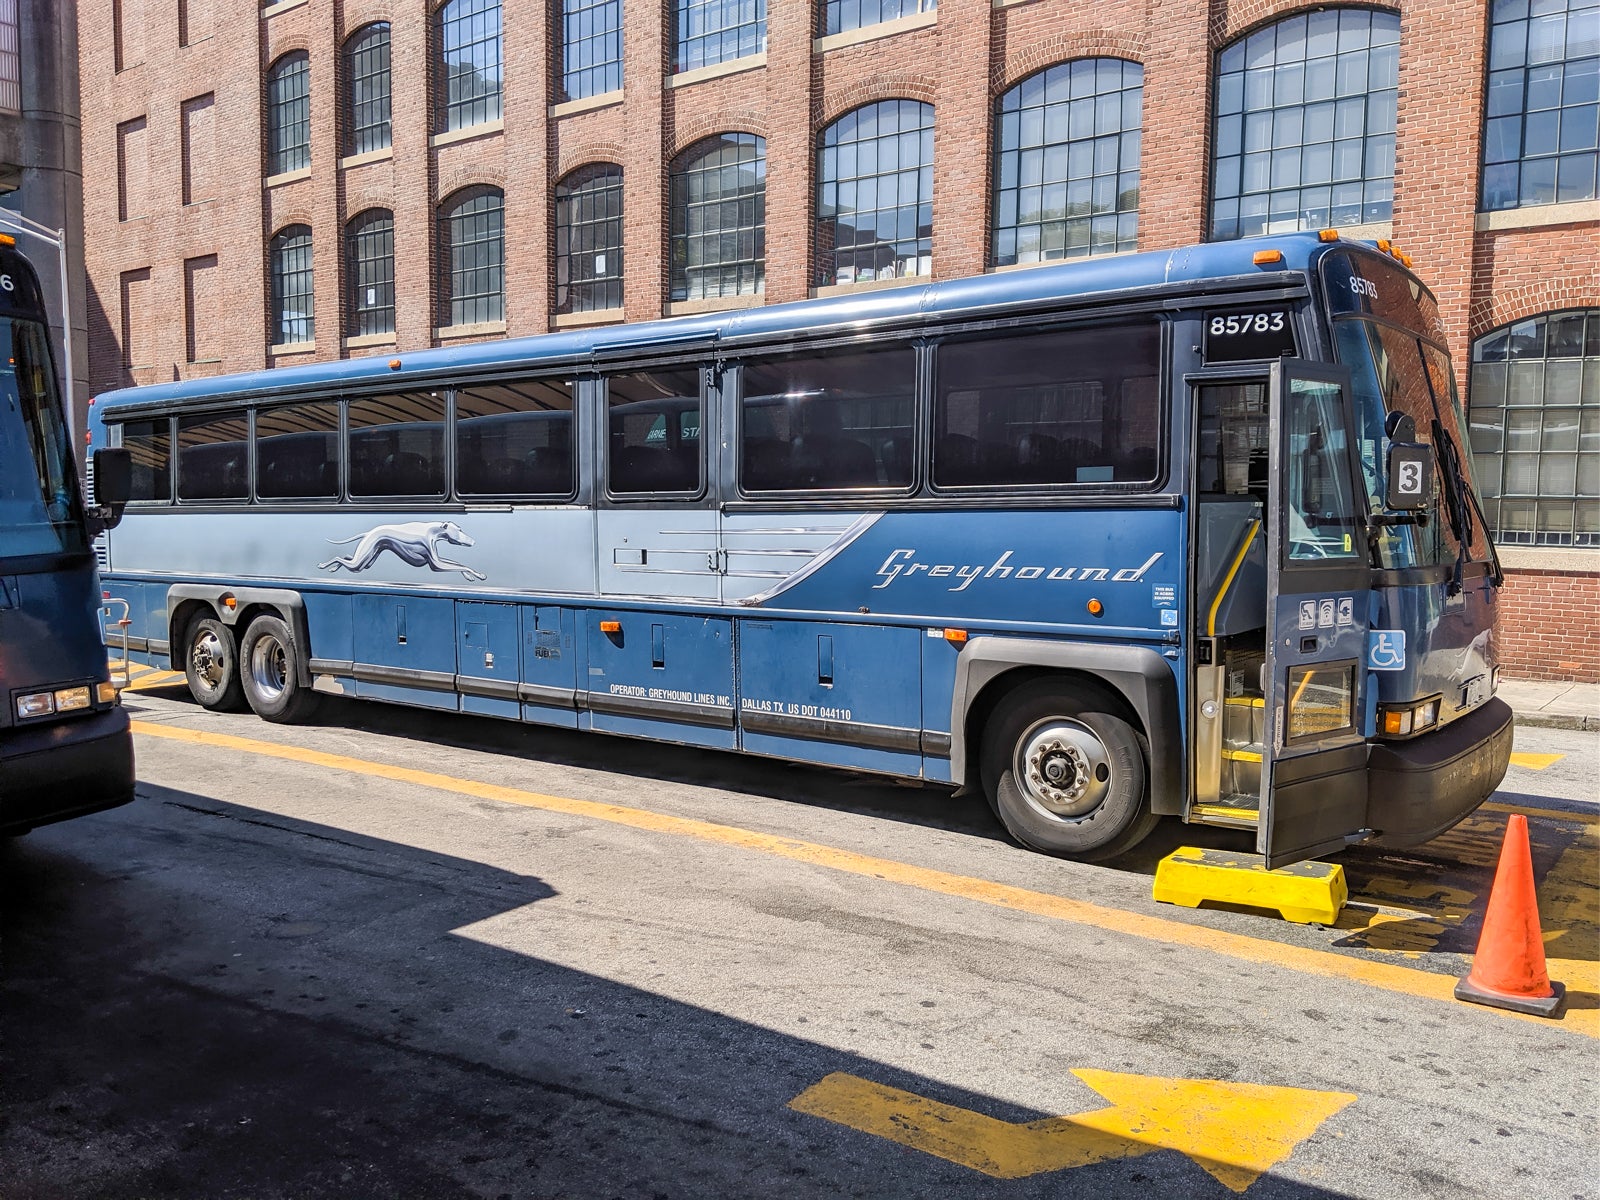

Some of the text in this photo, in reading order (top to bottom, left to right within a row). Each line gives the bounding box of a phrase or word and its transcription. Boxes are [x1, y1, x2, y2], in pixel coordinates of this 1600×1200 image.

[1349, 276, 1378, 299] 85783
[1210, 311, 1284, 335] 85783
[1401, 464, 1418, 491] 3
[872, 549, 1164, 591] Greyhound
[610, 684, 851, 720] OPERATOR: GREYHOUND LINES INC. DALLAS TX US DOT 044110
